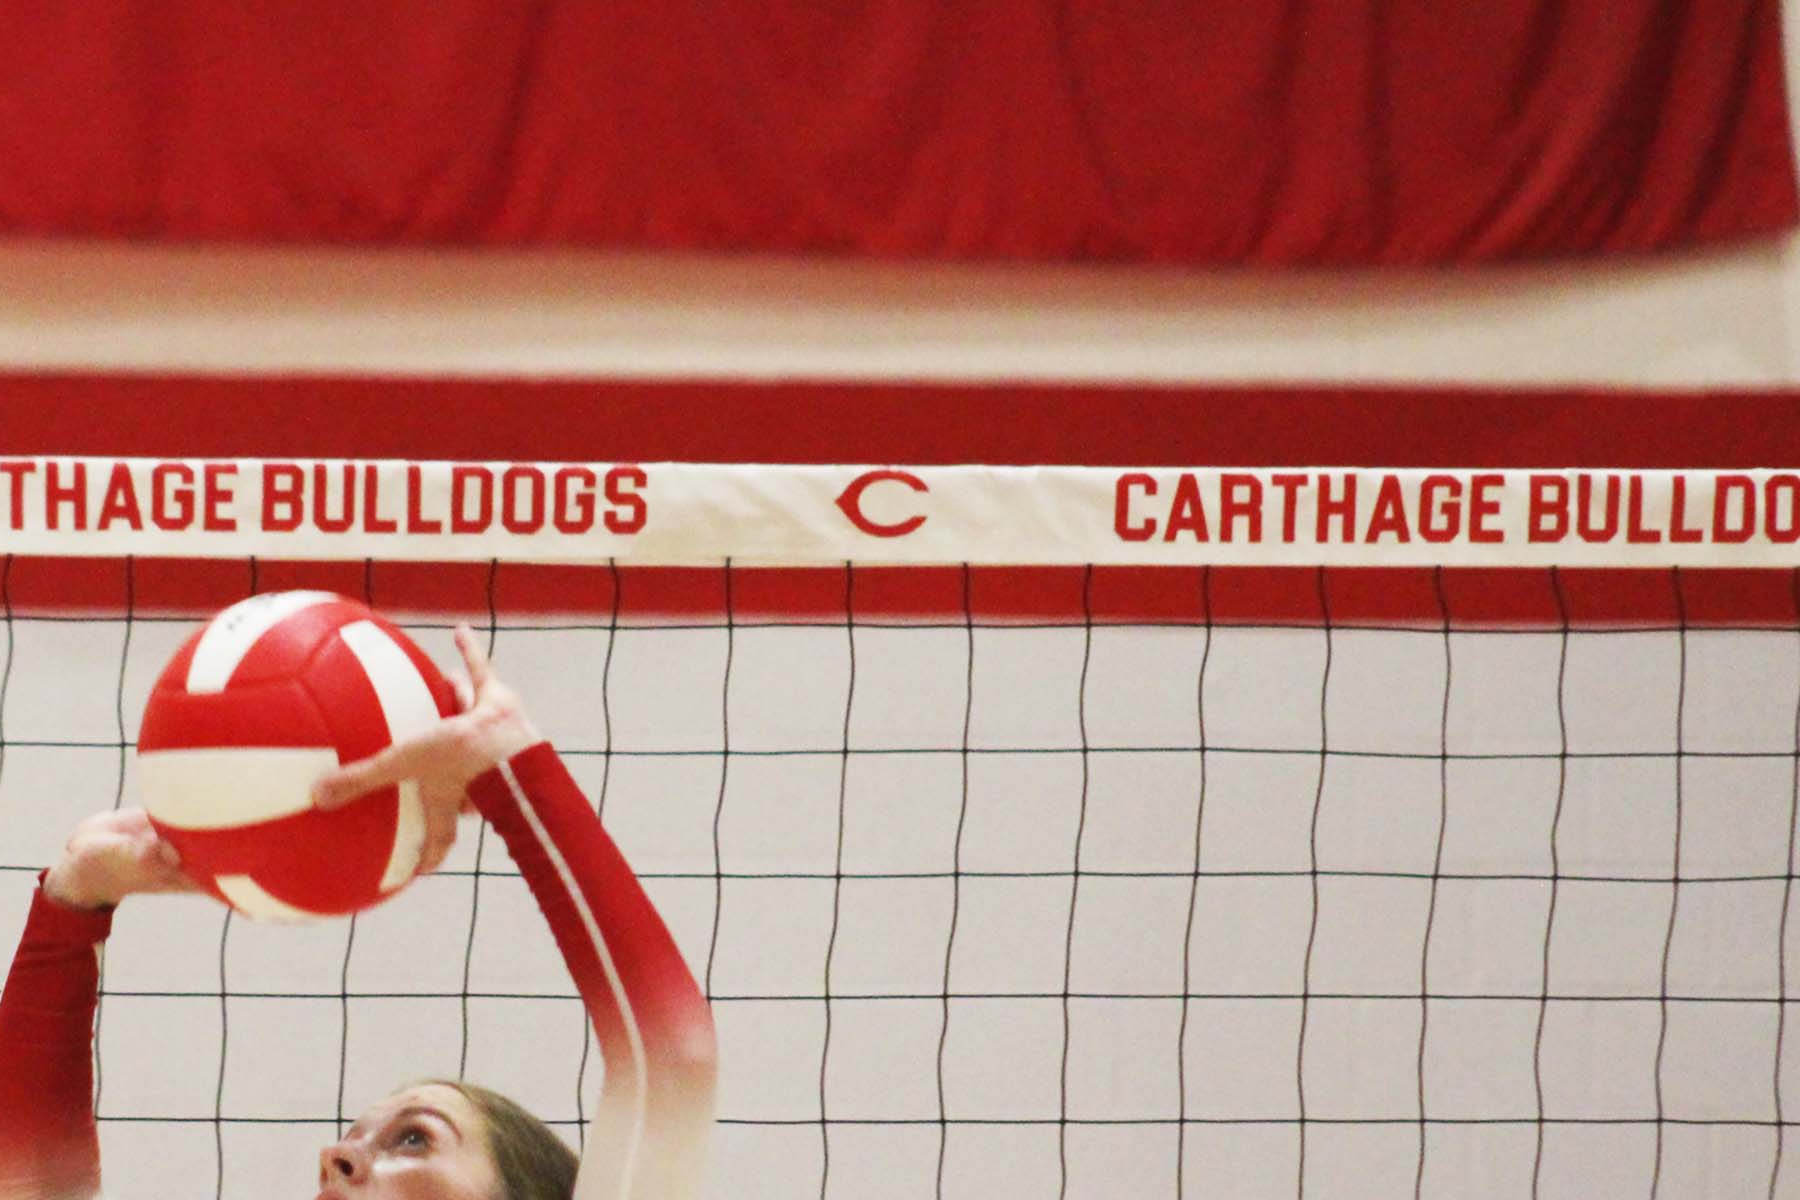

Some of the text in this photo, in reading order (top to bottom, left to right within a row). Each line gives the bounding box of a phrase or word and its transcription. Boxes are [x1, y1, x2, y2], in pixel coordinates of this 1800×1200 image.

[261, 463, 648, 535] BULLDOGS
[835, 469, 929, 538] C
[1114, 472, 1800, 544] CARTHAGE BULLDO
